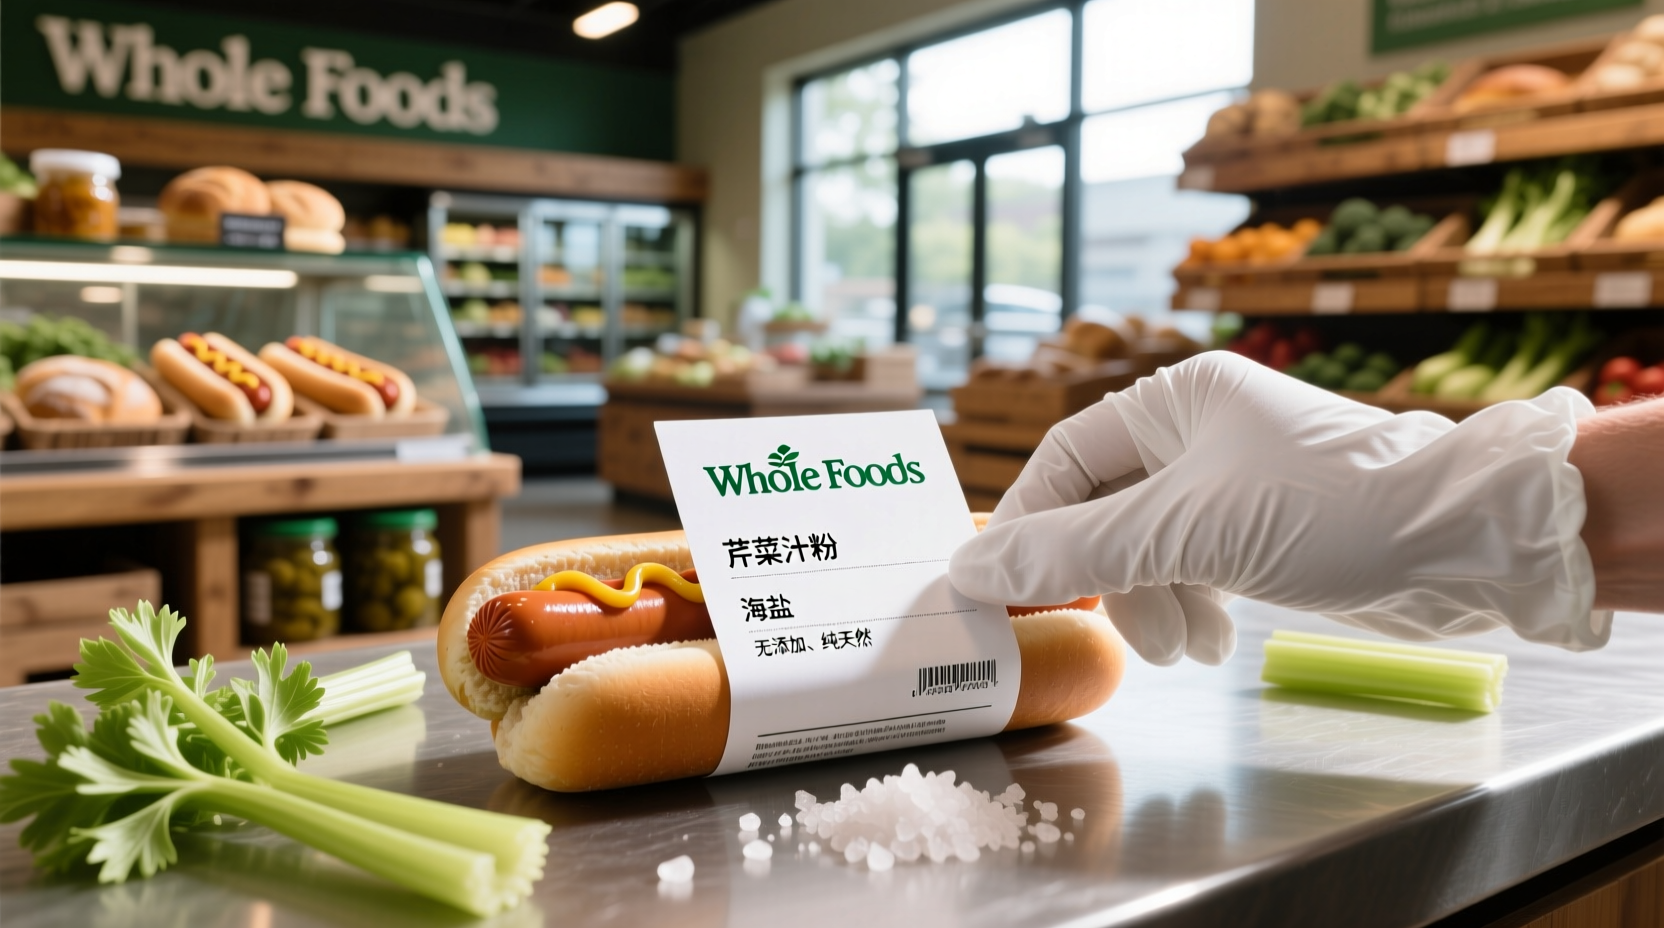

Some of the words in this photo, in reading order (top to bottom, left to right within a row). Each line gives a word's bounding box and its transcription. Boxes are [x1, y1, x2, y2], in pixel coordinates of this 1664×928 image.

[36, 14, 293, 116] Whole
[301, 46, 500, 136] Foods
[703, 460, 822, 497] Whole
[822, 453, 926, 489] Foods
[721, 532, 839, 569] 芹菜汁粉
[740, 593, 795, 622] 海盐
